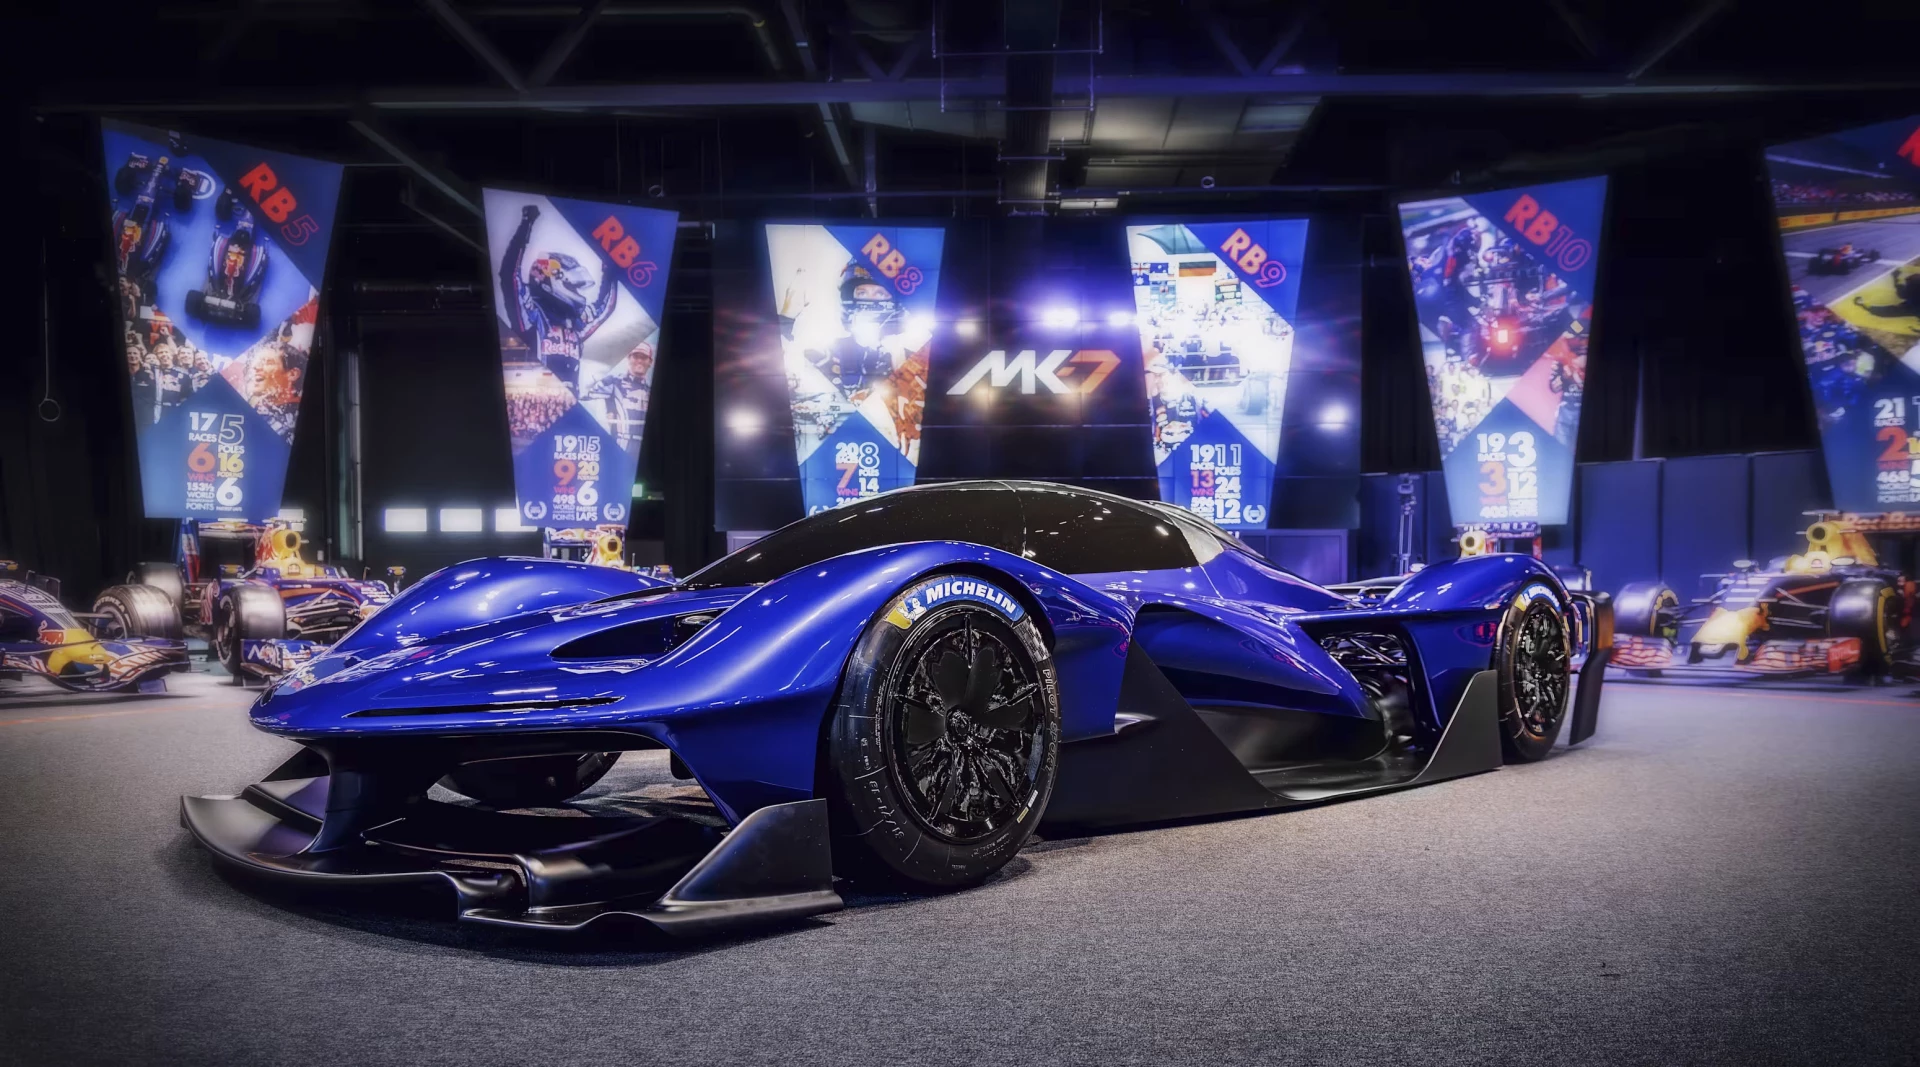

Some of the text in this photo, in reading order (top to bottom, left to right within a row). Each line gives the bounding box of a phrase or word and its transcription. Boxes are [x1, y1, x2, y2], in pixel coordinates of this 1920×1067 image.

[239, 161, 320, 247] RB5
[1503, 193, 1593, 273] RB10
[591, 215, 658, 288] RB6
[1220, 228, 1287, 288] RB9
[861, 232, 924, 296] RB8
[946, 350, 1122, 395] MK7
[1874, 397, 1905, 419] 21
[189, 412, 218, 431] 17
[218, 414, 245, 446] 5
[188, 432, 217, 443] RACES
[554, 435, 577, 452] 19
[578, 436, 601, 454] 15
[1477, 433, 1505, 452] 19
[1876, 426, 1909, 461] 2
[188, 442, 216, 473] 6
[218, 444, 245, 454] POLES
[554, 452, 577, 460] RACES
[836, 442, 859, 456] 20
[859, 442, 880, 469] 8
[1190, 444, 1215, 462] 19
[1215, 444, 1241, 466] 11
[1507, 431, 1537, 467] 3
[218, 453, 244, 473] 16
[554, 459, 576, 486] 9
[578, 461, 600, 476] 20
[836, 463, 859, 489] 7
[859, 477, 879, 492] 14
[1191, 470, 1214, 488] 13
[1215, 476, 1241, 493] 24
[1479, 461, 1507, 496] 3
[1507, 471, 1537, 494] 12
[187, 491, 215, 499] WORLD
[216, 478, 243, 506] 6
[553, 494, 575, 505] 498
[577, 481, 598, 506] 6
[186, 502, 214, 511] POINTS
[576, 512, 597, 521] LAPS
[1215, 499, 1240, 518] 12
[925, 581, 1016, 614] MICHELIN
[1042, 668, 1058, 717] PILOT
